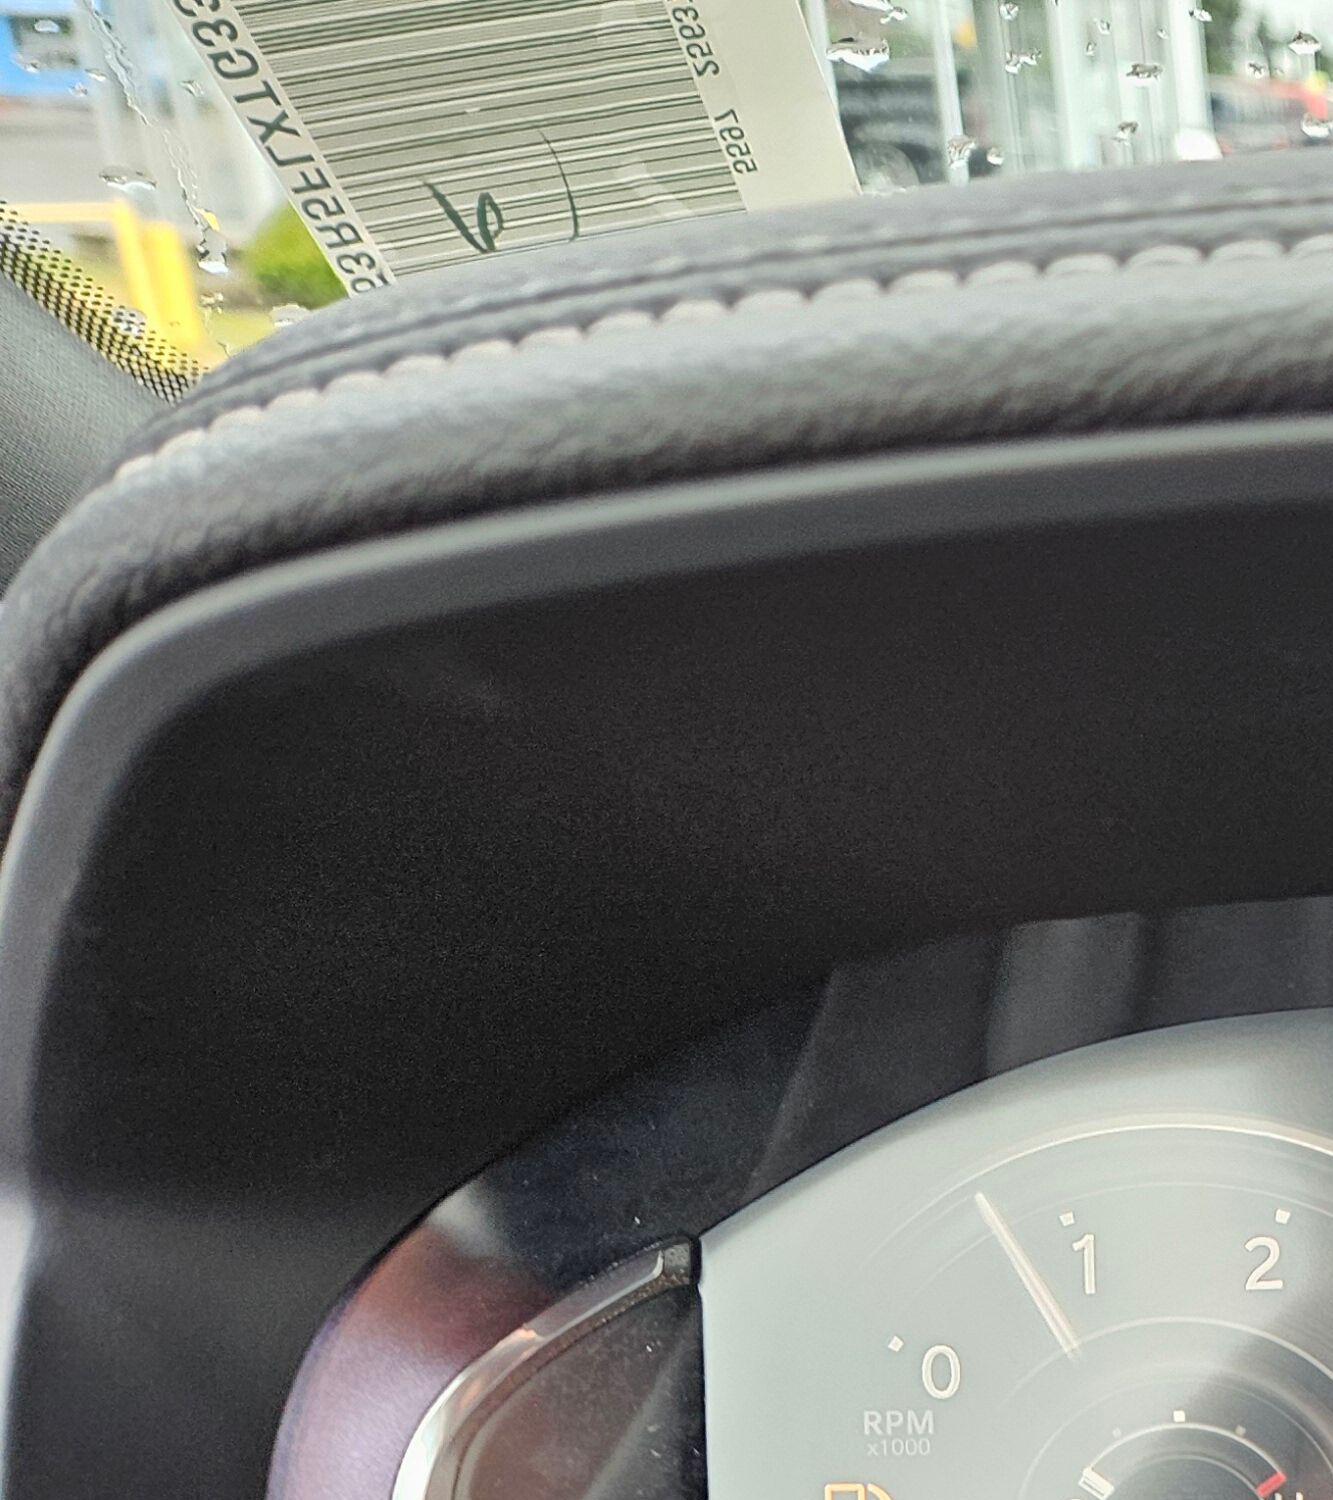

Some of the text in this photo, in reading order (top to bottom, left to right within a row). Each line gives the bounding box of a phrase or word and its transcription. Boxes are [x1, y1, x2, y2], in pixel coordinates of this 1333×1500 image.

[1071, 1234, 1097, 1295] 1
[1245, 1236, 1284, 1290] 2
[921, 1344, 961, 1398] 0
[862, 1410, 935, 1436] RPM
[866, 1439, 932, 1456] x1000
